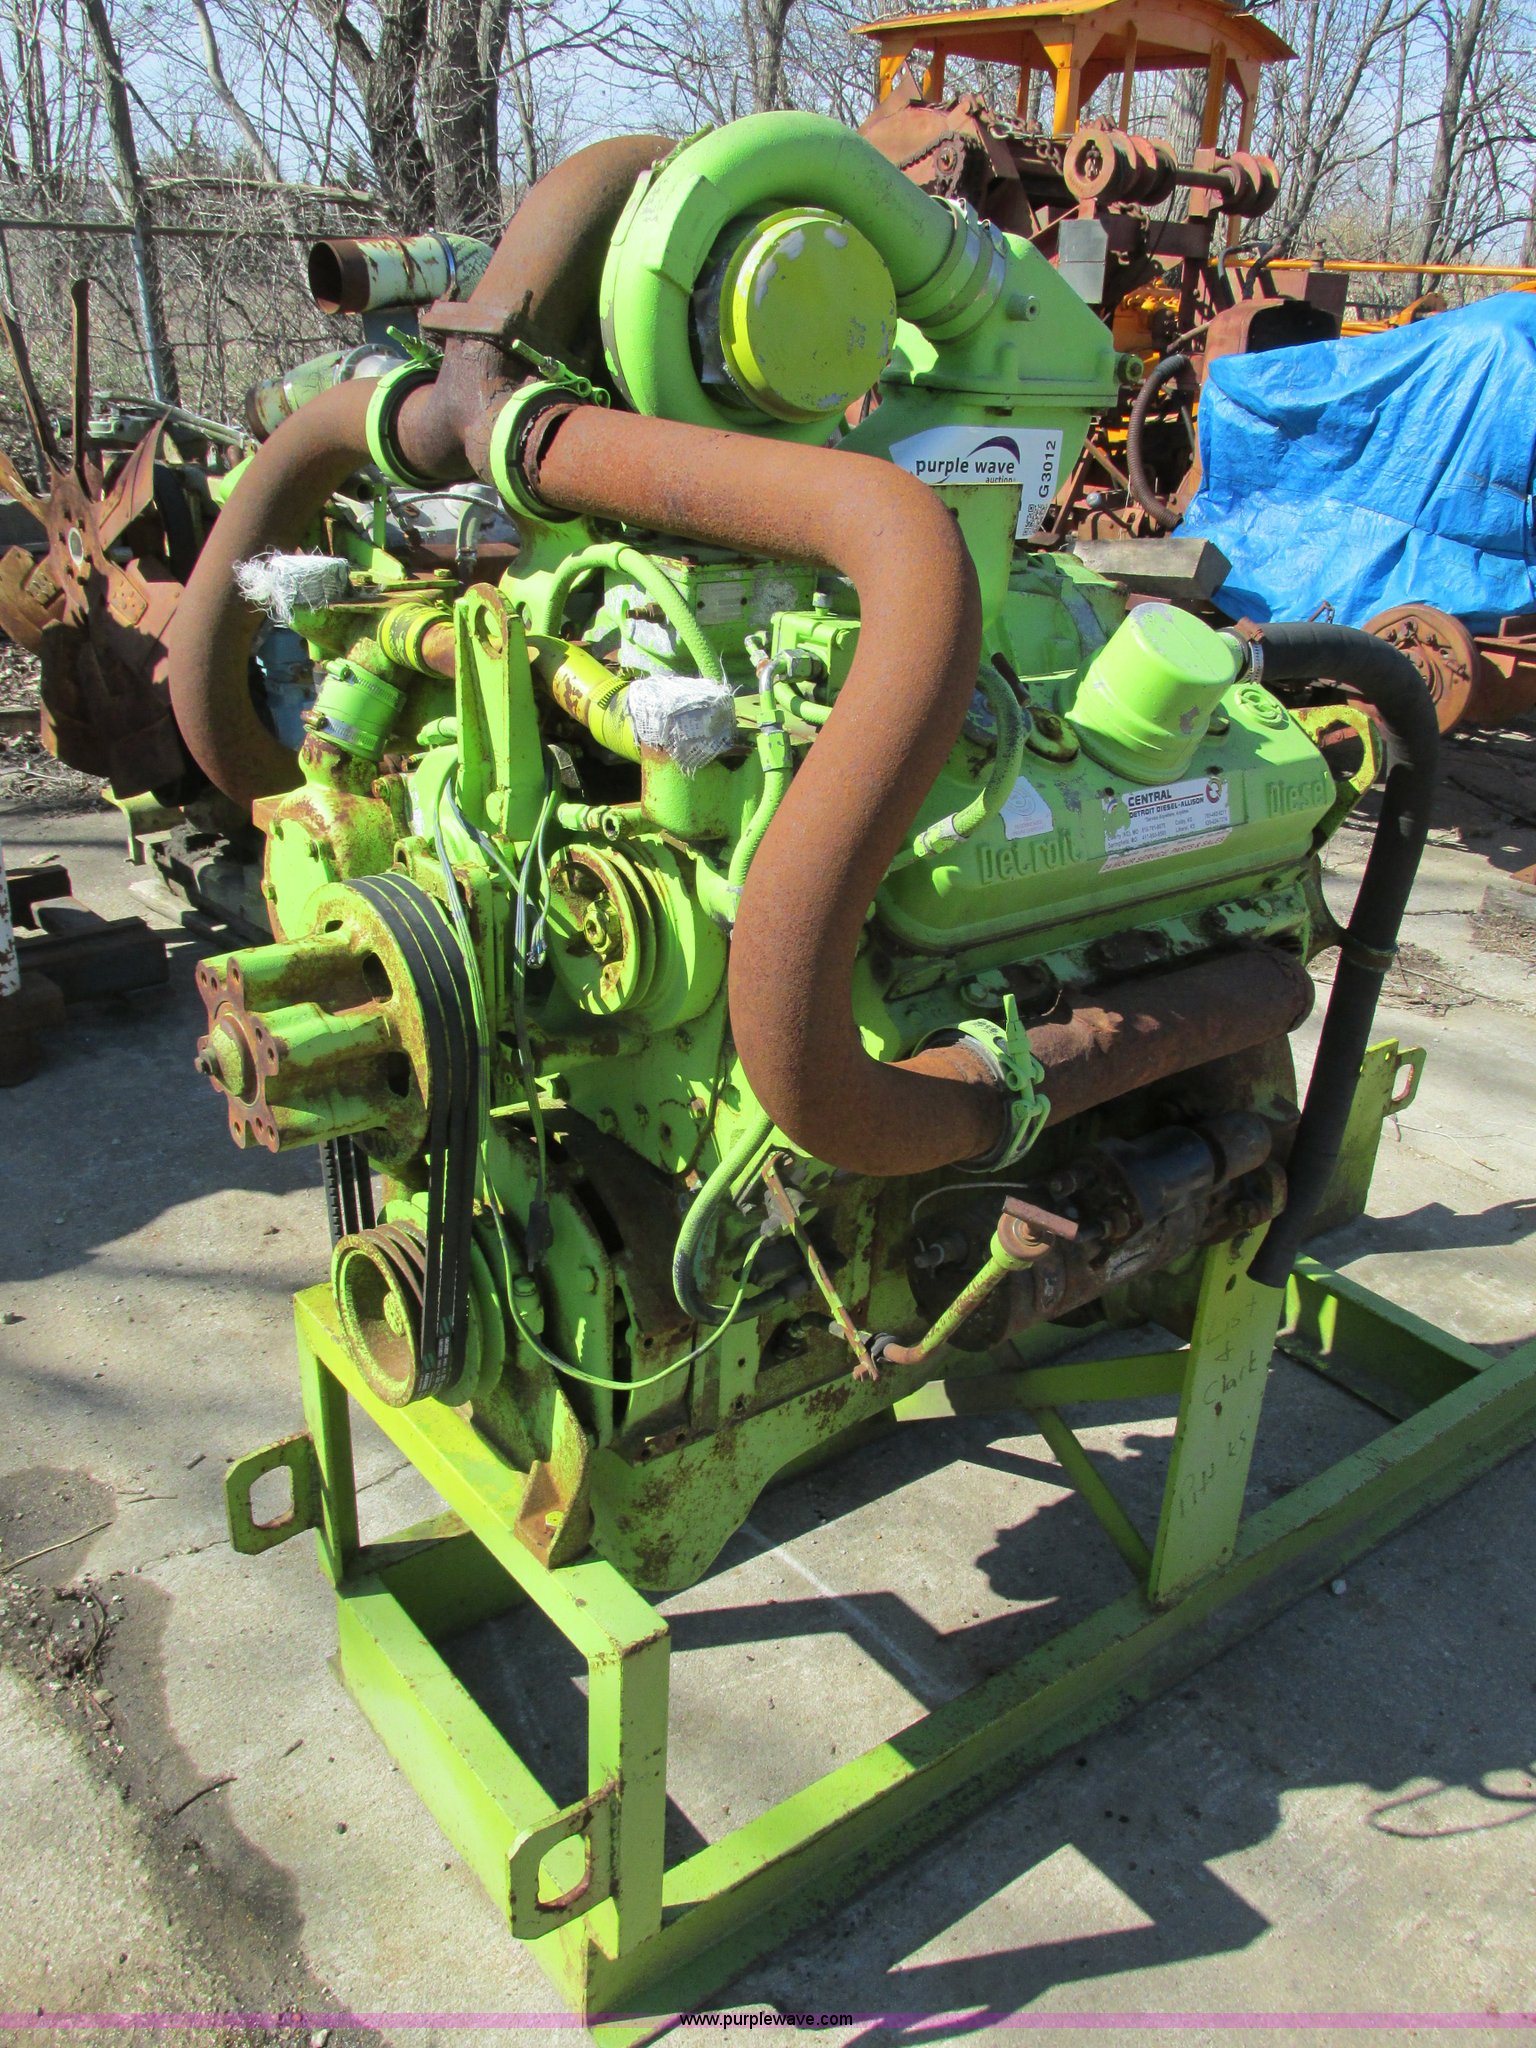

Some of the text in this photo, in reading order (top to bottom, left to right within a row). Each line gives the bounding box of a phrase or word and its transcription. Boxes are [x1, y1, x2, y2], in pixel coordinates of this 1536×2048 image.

[916, 457, 1015, 476] purple wave
[1038, 440, 1057, 498] G3012
[1128, 789, 1172, 807] CENTRAL
[1129, 798, 1204, 819] DETROIT DIESEL-ALLISON
[977, 830, 1079, 884] Detroit
